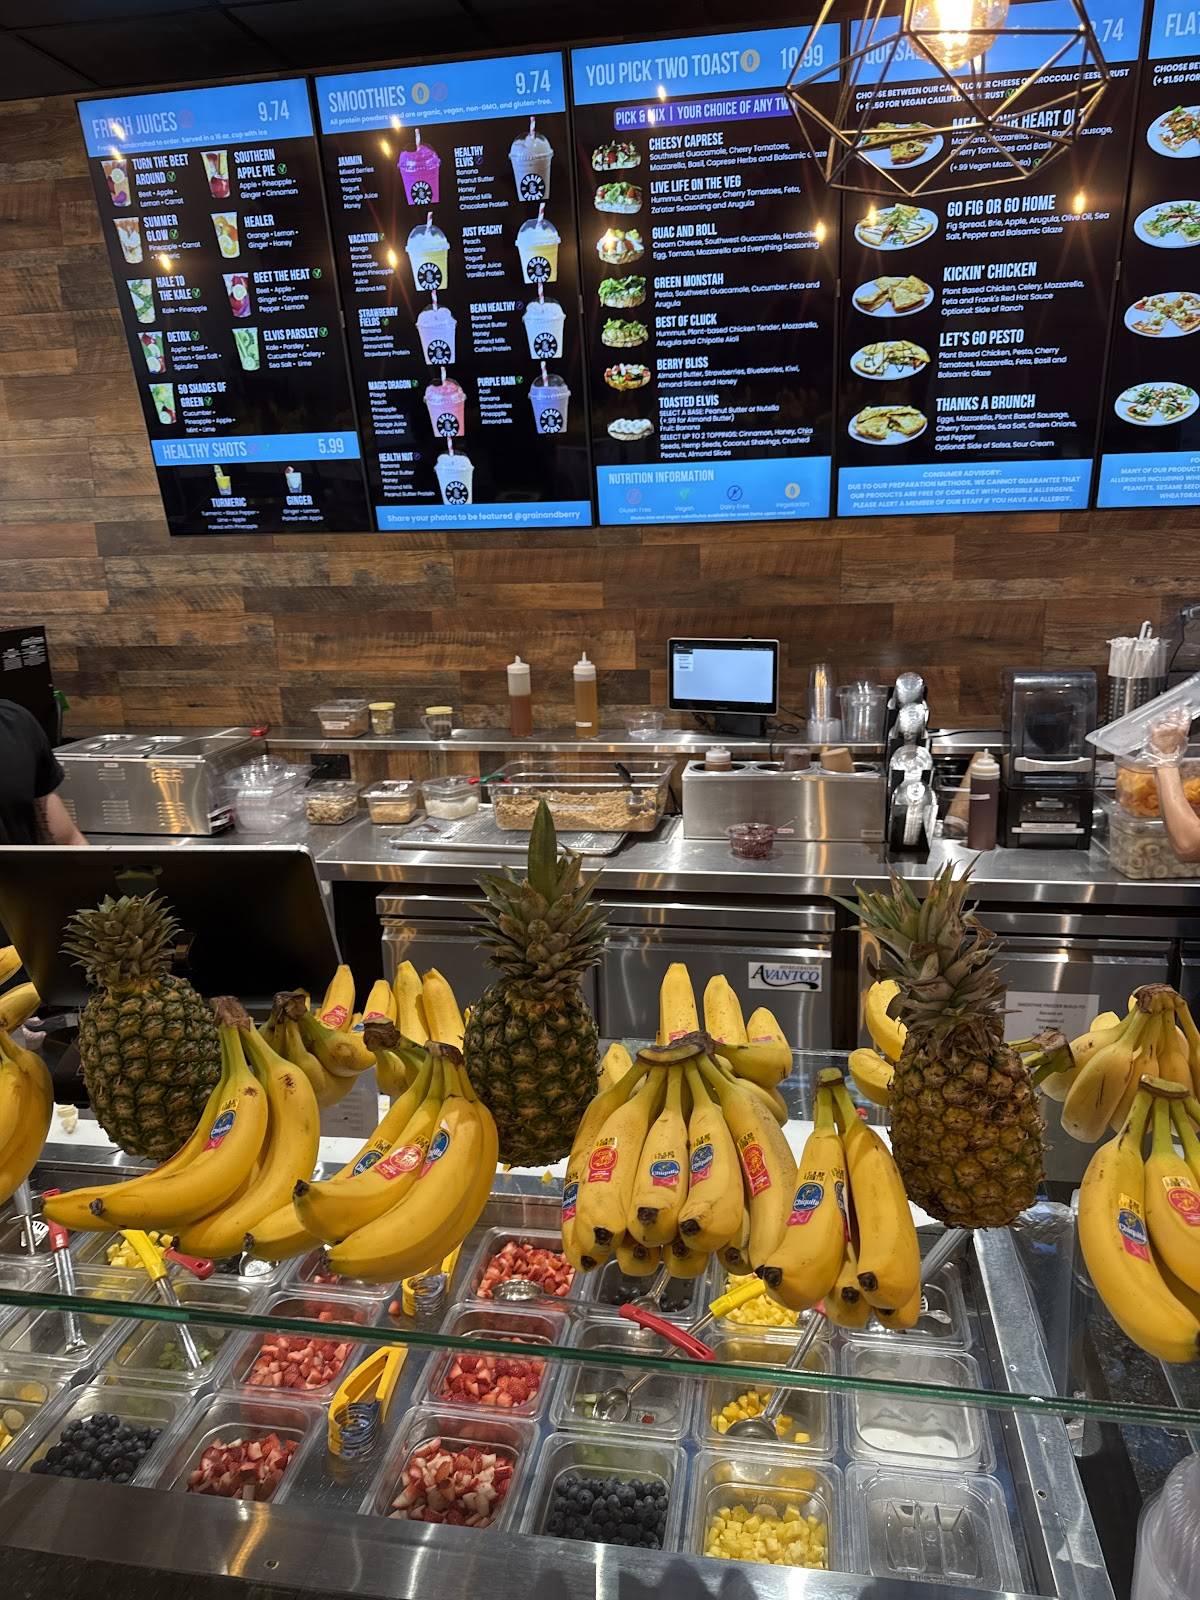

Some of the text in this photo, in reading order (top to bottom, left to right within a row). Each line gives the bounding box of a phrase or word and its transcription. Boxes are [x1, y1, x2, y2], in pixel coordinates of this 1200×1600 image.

[780, 44, 823, 69] 10.99
[585, 51, 739, 87] YOU PICK TWO TOAST
[1154, 62, 1187, 74] CHOOSE
[514, 70, 551, 94] 9.74
[327, 85, 406, 112] SMOOTHIES
[256, 99, 290, 121] 9.74
[615, 110, 636, 125] PICK
[639, 109, 645, 123] &
[677, 104, 701, 119] YOUR
[704, 101, 737, 117] CHOICE
[739, 100, 750, 114] OF
[754, 98, 772, 113] ANY
[133, 111, 177, 134] JUICES
[1021, 109, 1060, 128] HEART
[649, 132, 723, 150] CHEESY CAPRESE
[233, 148, 275, 163] SOUTHERN
[454, 146, 483, 157] HEALTHY
[131, 153, 189, 169] TURN THE BEET
[455, 156, 473, 167] ELVIS
[134, 171, 166, 185] AROUND
[236, 164, 275, 178] APPLE PIE
[650, 175, 740, 193] LIVE LIFE ON THE VEG
[946, 194, 1055, 216] GO FIG OR GO HOME
[143, 215, 177, 227] SUMMER
[243, 215, 274, 227] HEALER
[145, 229, 168, 241] GLOW
[462, 225, 502, 237] JUST PEACHY
[652, 223, 717, 238] GUAC AND ROLL
[348, 233, 378, 243] VACATION
[253, 268, 310, 283] BEET THE HEAT
[943, 261, 1037, 281] KICKIN' CHICKEN
[155, 275, 185, 287] HALE TO
[654, 273, 724, 288] GREEN MONSTAH
[158, 289, 192, 300] THE KALE
[358, 307, 398, 318] STRAWBERRY
[470, 301, 515, 313] BEAN HEALTHY
[655, 313, 717, 327] BEST OF CLUCK
[166, 331, 191, 341] DETOX
[262, 327, 318, 341] ELVIS PARSLEY
[939, 329, 1024, 346] LET'S GO PESTO
[657, 357, 708, 370] BERRY BLISS
[177, 382, 227, 393] 50 SHADES OF
[368, 381, 386, 390] MAGIC
[477, 376, 515, 386] PURPLE RAIN
[180, 397, 204, 407] GREEN
[658, 395, 718, 408] TOASTED ELVIS
[936, 394, 1035, 411] THANKS A BRUNCH
[162, 442, 247, 459] HEALTHY SHOTS
[318, 438, 344, 453] 5.99
[378, 453, 400, 461] HEALTH
[608, 469, 714, 484] NUTRITION INFORMATION
[285, 495, 312, 505] GINGER
[751, 964, 820, 985] AVANTCO
